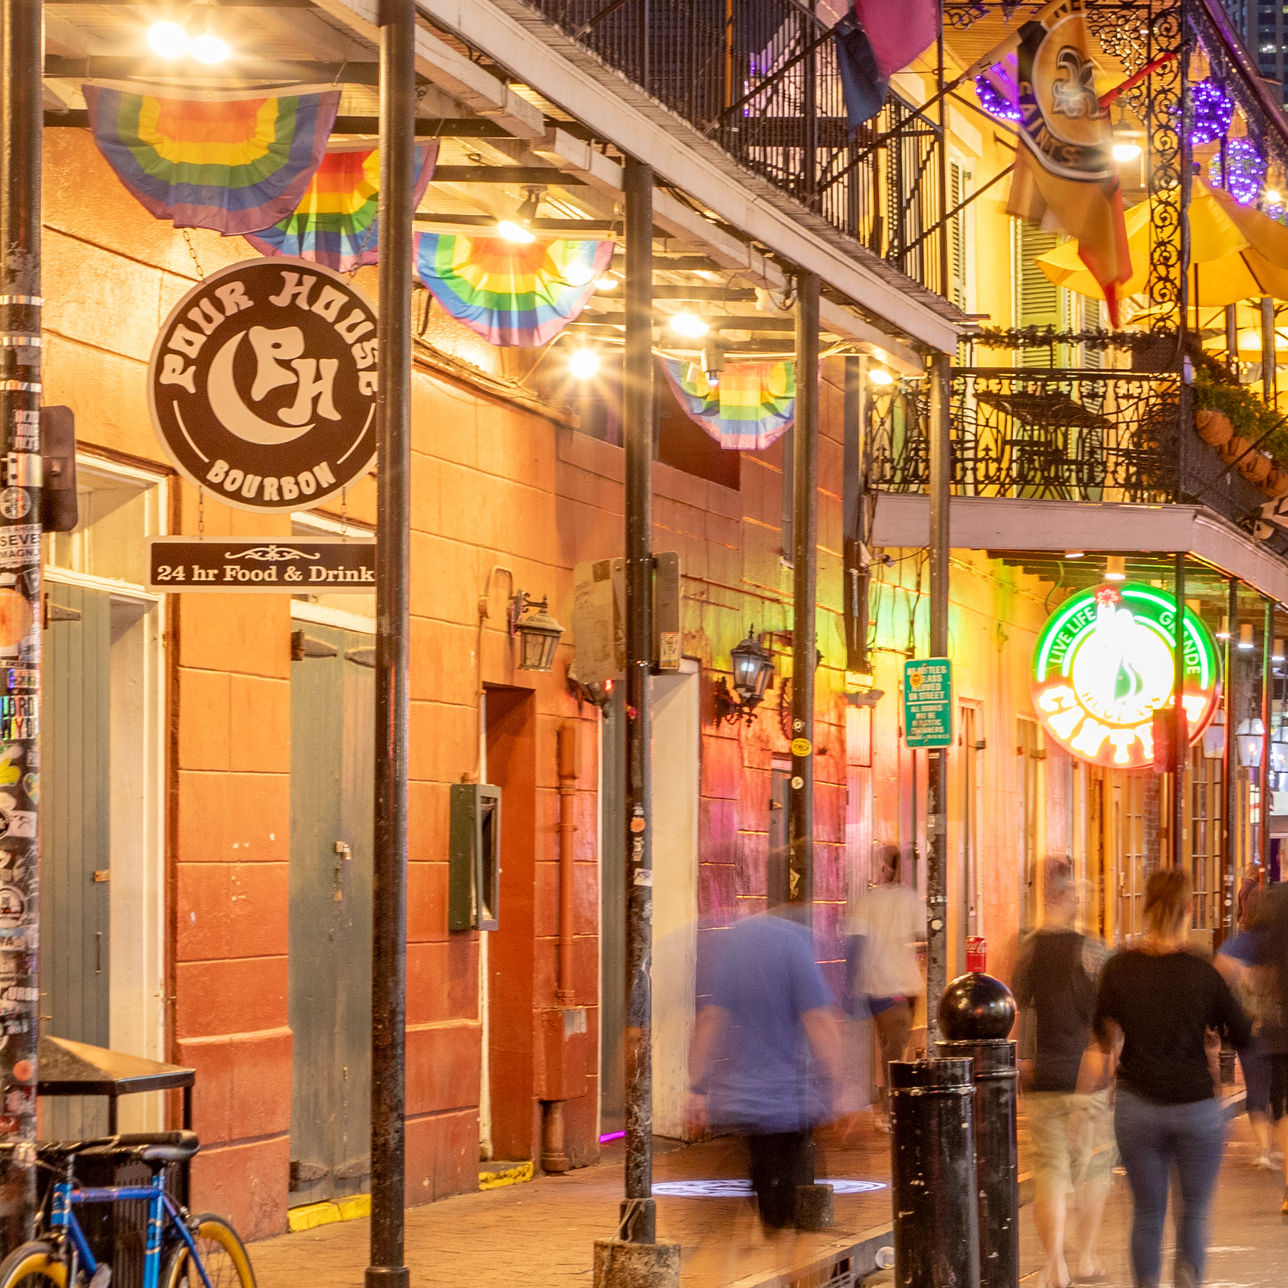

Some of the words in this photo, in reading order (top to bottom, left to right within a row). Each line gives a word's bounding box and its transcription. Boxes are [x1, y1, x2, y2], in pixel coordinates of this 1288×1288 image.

[159, 281, 255, 394] POUR
[268, 271, 378, 396] HOUSE
[206, 459, 336, 501] BOURBON
[157, 565, 185, 581] 24
[192, 565, 219, 581] hr
[222, 565, 278, 582] Food
[283, 566, 303, 582] &
[1049, 632, 1072, 664] LIVE
[1066, 606, 1097, 633] LIFE
